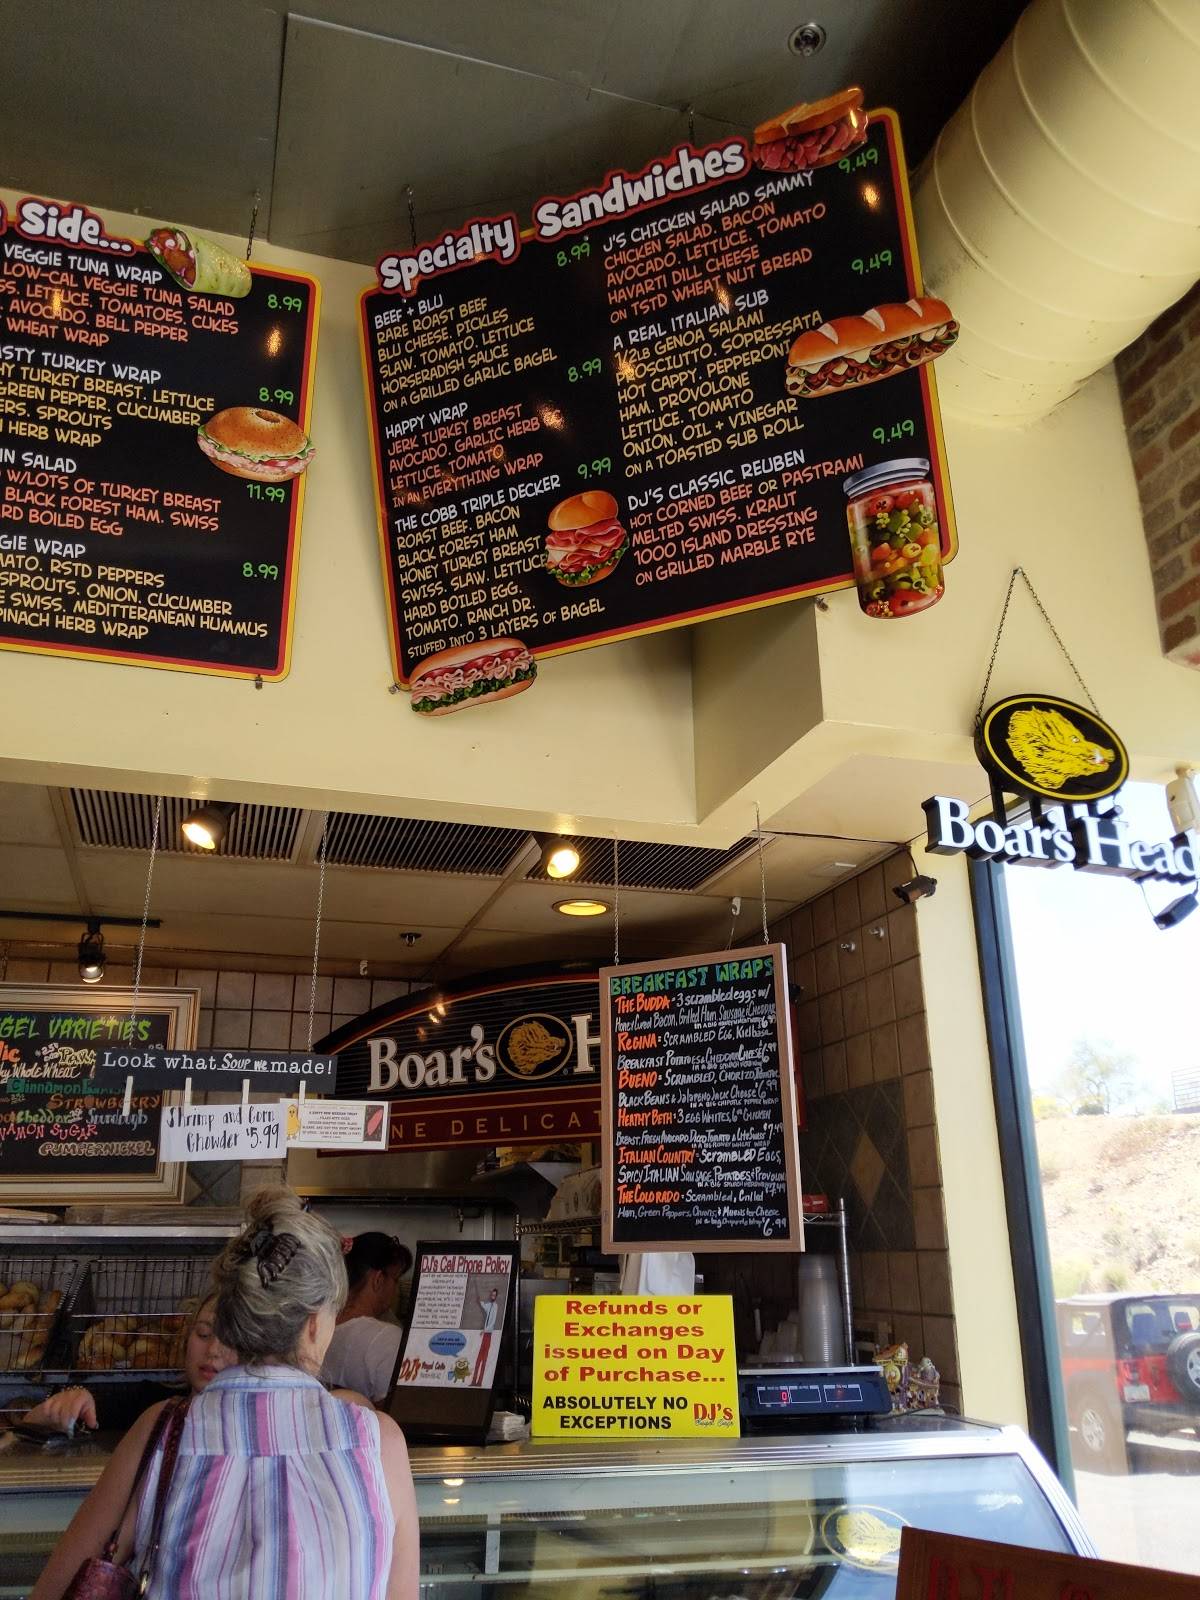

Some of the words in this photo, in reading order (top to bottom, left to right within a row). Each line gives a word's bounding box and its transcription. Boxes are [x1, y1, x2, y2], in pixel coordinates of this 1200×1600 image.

[838, 148, 878, 174] 9.49
[380, 219, 515, 291] Specialty
[536, 143, 744, 237] Sandwiches
[603, 233, 627, 253] J'S
[631, 211, 695, 242] CHICKEN
[699, 192, 749, 220] SALAD
[753, 171, 815, 200] SAMMY
[757, 203, 825, 237] TOMATO
[21, 202, 132, 252] Side...
[604, 239, 661, 269] CHICKEN
[721, 202, 774, 230] BACON
[4, 243, 61, 266] VEGGIE
[67, 255, 109, 276] TUNA
[115, 264, 162, 284] WRAP
[557, 242, 590, 266] 8.99
[851, 250, 892, 276] 9.49
[3, 262, 78, 287] LOW-CAL
[83, 275, 137, 297] VEGGIE
[143, 287, 182, 307] TUNA
[187, 295, 234, 316] SALAD
[267, 294, 302, 312] 8.99
[374, 308, 401, 329] BEEF
[407, 307, 414, 315] +
[418, 294, 442, 314] BLU
[377, 323, 408, 344] RARE
[412, 307, 454, 332] ROAST
[459, 297, 486, 317] BEEF
[482, 317, 534, 345] LETTUCE
[613, 335, 623, 350] A
[628, 323, 666, 344] REAL
[671, 300, 729, 331] ITALIAN
[734, 289, 768, 311] SUB
[378, 343, 401, 362] BLU
[456, 308, 508, 336] PICKLES
[613, 344, 651, 368] 1/2LB
[654, 328, 705, 355] GENOA
[708, 309, 763, 337] SALAMI
[41, 352, 105, 375] TURKEY
[112, 363, 161, 384] WRAP
[383, 399, 397, 412] ON
[400, 396, 407, 406] A
[409, 378, 459, 404] GRILLED
[463, 361, 510, 387] GARLIC
[514, 347, 557, 371] BAGEL
[568, 358, 602, 382] 8.99
[258, 387, 294, 405] 8.99
[385, 414, 424, 438] HAPPY
[429, 402, 467, 424] WRAP
[388, 435, 418, 455] JERK
[422, 420, 468, 444] TURKEY
[473, 403, 521, 430] BREAST
[872, 420, 914, 444] 9.49
[578, 457, 611, 479] 9.99
[627, 487, 663, 510] DJ'S
[668, 469, 735, 499] CLASSIC
[740, 449, 805, 479] REUBEN
[6, 469, 68, 490] W/LOTS
[73, 478, 95, 494] OF
[100, 482, 159, 503] TURKEY
[163, 492, 221, 513] BREAST
[246, 484, 285, 503] 11.99
[394, 514, 417, 533] THE
[421, 504, 457, 526] COBB
[461, 489, 505, 514] TRIPLE
[508, 474, 560, 501] DECKER
[5, 486, 55, 507] BLACK
[60, 495, 120, 516] FOREST
[170, 511, 218, 531] SWISS
[396, 526, 437, 549] ROAST
[475, 505, 520, 529] BACON
[633, 541, 676, 565] 1000
[681, 529, 731, 554] ISLAND
[735, 506, 817, 539] DRESSING
[242, 562, 278, 580] 8.99
[72, 599, 195, 627] MEDITTERANEAN
[200, 615, 267, 637] HUMMUS
[932, 795, 1076, 863] Boar's
[1080, 815, 1200, 878] Head
[611, 966, 708, 995] BREAKFAST
[715, 957, 774, 982] WRAPS
[637, 993, 670, 1012] BUDDA
[733, 989, 756, 1005] eggs
[48, 1016, 152, 1040] VARIETIES
[663, 1031, 716, 1047] SCRAMBLED
[102, 1052, 156, 1068] Look
[163, 1054, 217, 1070] what
[269, 1060, 333, 1075] made!
[367, 1024, 497, 1093] Boar's
[618, 1068, 657, 1089] BUENO
[166, 1107, 214, 1132] Shrimp
[222, 1106, 243, 1125] and
[248, 1105, 275, 1125] Corn
[652, 1110, 673, 1125] BETH
[50, 1123, 98, 1141] SUGAR
[186, 1130, 240, 1153] Chowder
[38, 1141, 156, 1157] PUMPERNICKEL
[618, 1147, 657, 1164] ITALIAN
[657, 1144, 695, 1164] COUNTRY
[633, 1183, 680, 1204] COLORADO
[421, 1255, 439, 1273] DJ's
[440, 1256, 456, 1273] Cell
[457, 1256, 483, 1274] Phone
[484, 1256, 510, 1274] Policy
[566, 1300, 667, 1316] Refunds
[677, 1304, 703, 1316] or
[564, 1322, 705, 1340] Exchanges
[544, 1343, 628, 1360] issued
[637, 1347, 668, 1360] on
[677, 1344, 725, 1364] Day
[544, 1366, 570, 1382] of
[579, 1366, 725, 1382] Purchase...
[543, 1396, 656, 1410] ABSOLUTELY
[663, 1396, 688, 1410] NO
[693, 1403, 734, 1421] DJ's
[560, 1415, 672, 1429] EXCEPTIONS
